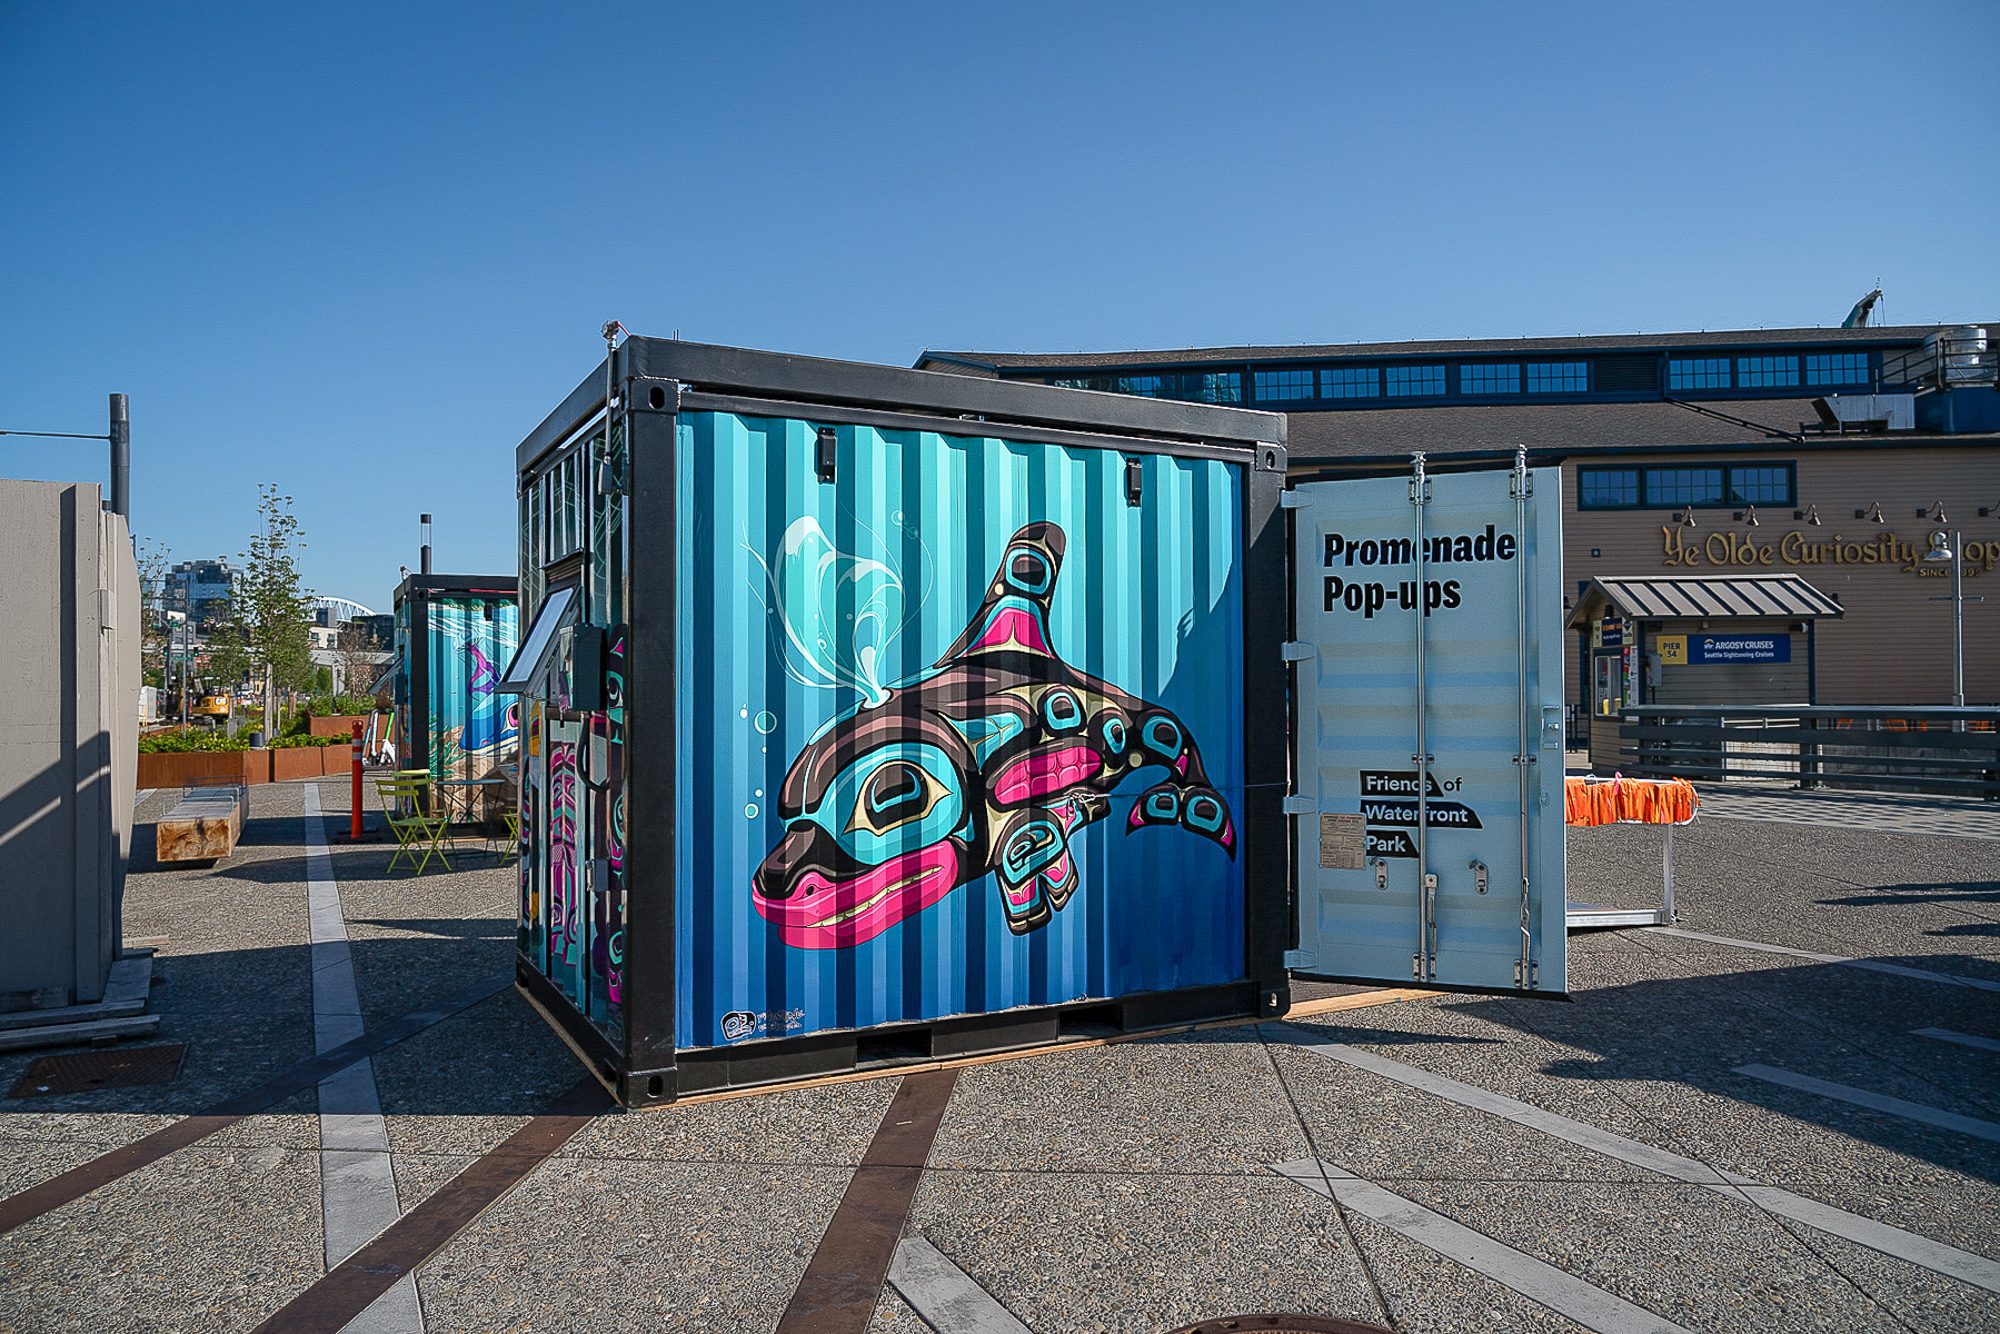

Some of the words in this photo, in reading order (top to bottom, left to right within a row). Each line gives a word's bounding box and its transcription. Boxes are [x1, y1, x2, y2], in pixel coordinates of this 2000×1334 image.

[1323, 524, 1516, 568] Promenade
[1662, 525, 1700, 567] Ye
[1704, 531, 1775, 566] Olde
[1780, 530, 1920, 572] Curiosity
[1919, 568, 1951, 577] SINCE
[1323, 575, 1462, 619] Pop-ups
[1663, 642, 1681, 650] PIER
[1715, 640, 1744, 650] ARGOSY
[1744, 640, 1774, 649] CRUISES
[1443, 776, 1462, 791] of
[1365, 835, 1406, 852] Park
